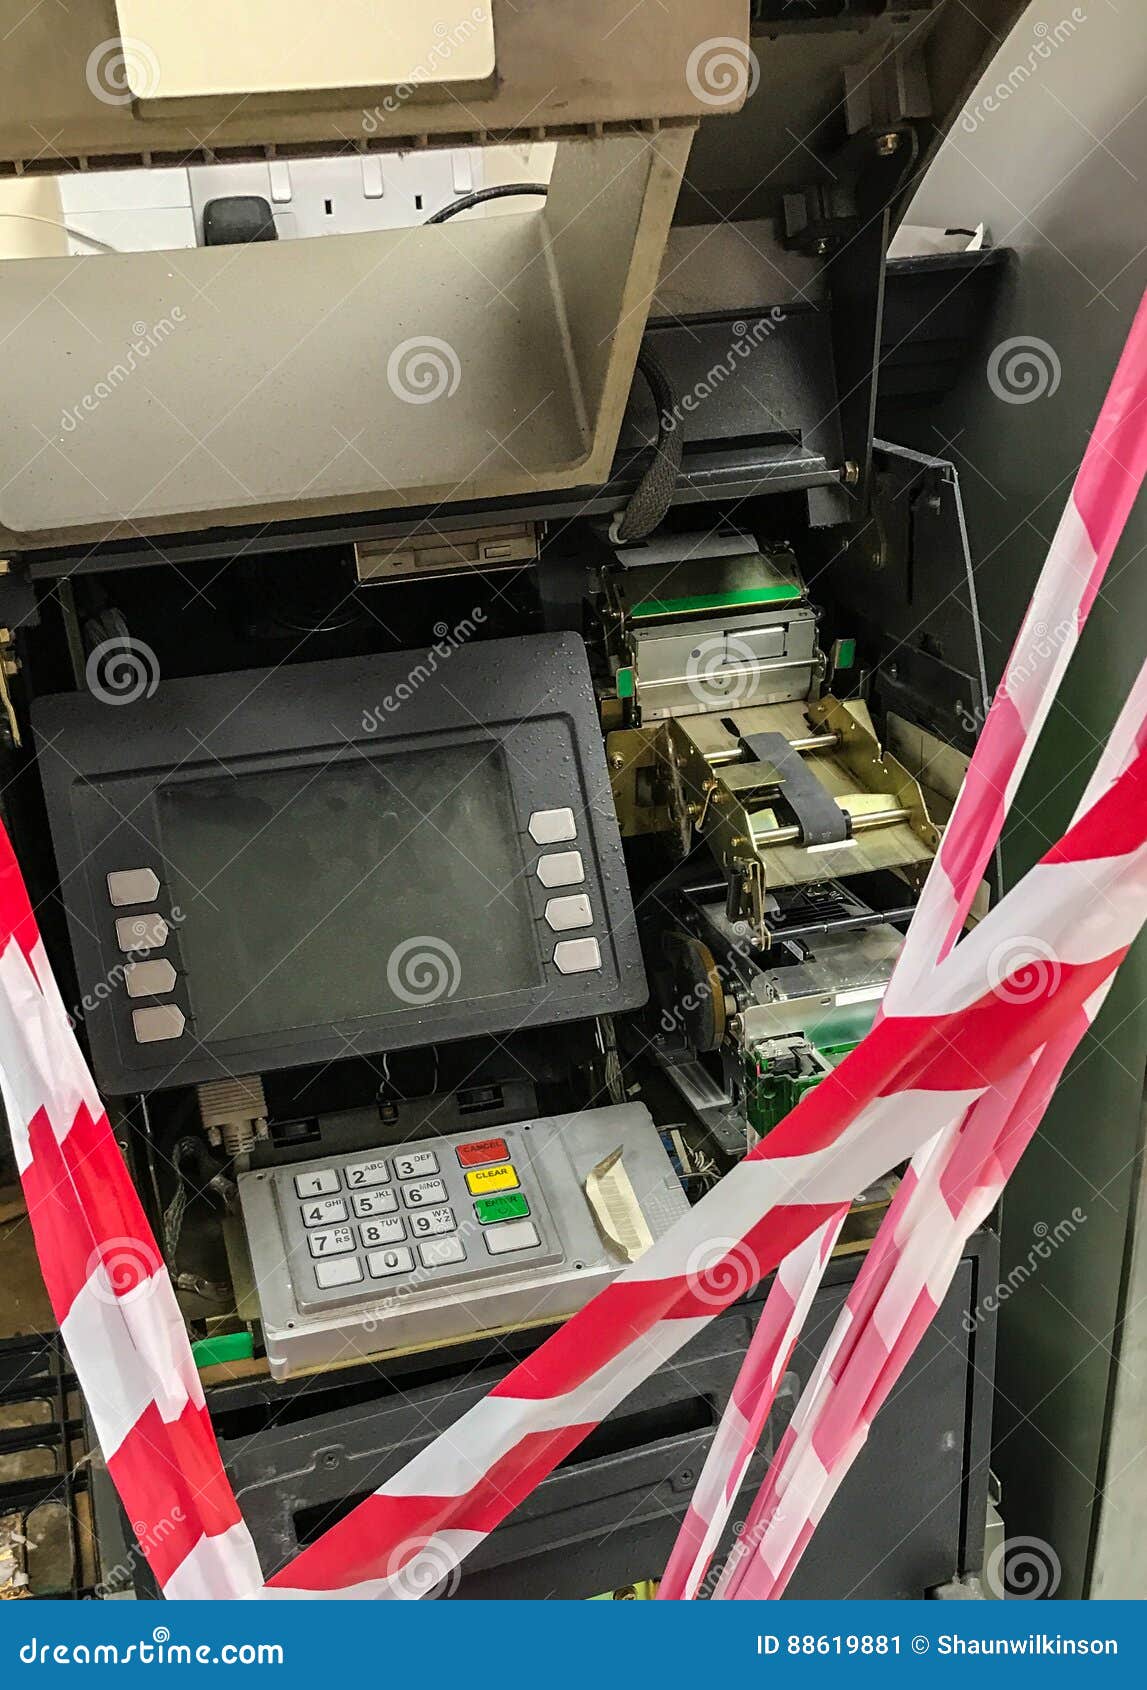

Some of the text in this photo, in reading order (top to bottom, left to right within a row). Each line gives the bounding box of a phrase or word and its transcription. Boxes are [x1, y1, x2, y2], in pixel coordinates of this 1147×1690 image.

[352, 1161, 384, 1185] 2 ABC
[401, 1153, 433, 1175] 3 DEF
[475, 1168, 508, 1180] CLEAR
[311, 1179, 324, 1192] 1
[409, 1180, 441, 1202] 6 MNO
[309, 1199, 342, 1221] 4 GHI
[360, 1190, 392, 1212] 5 JKL
[367, 1218, 399, 1241] 8 TUV
[416, 1217, 430, 1231] 9
[314, 1236, 327, 1251] 7
[384, 1251, 399, 1268] 0
